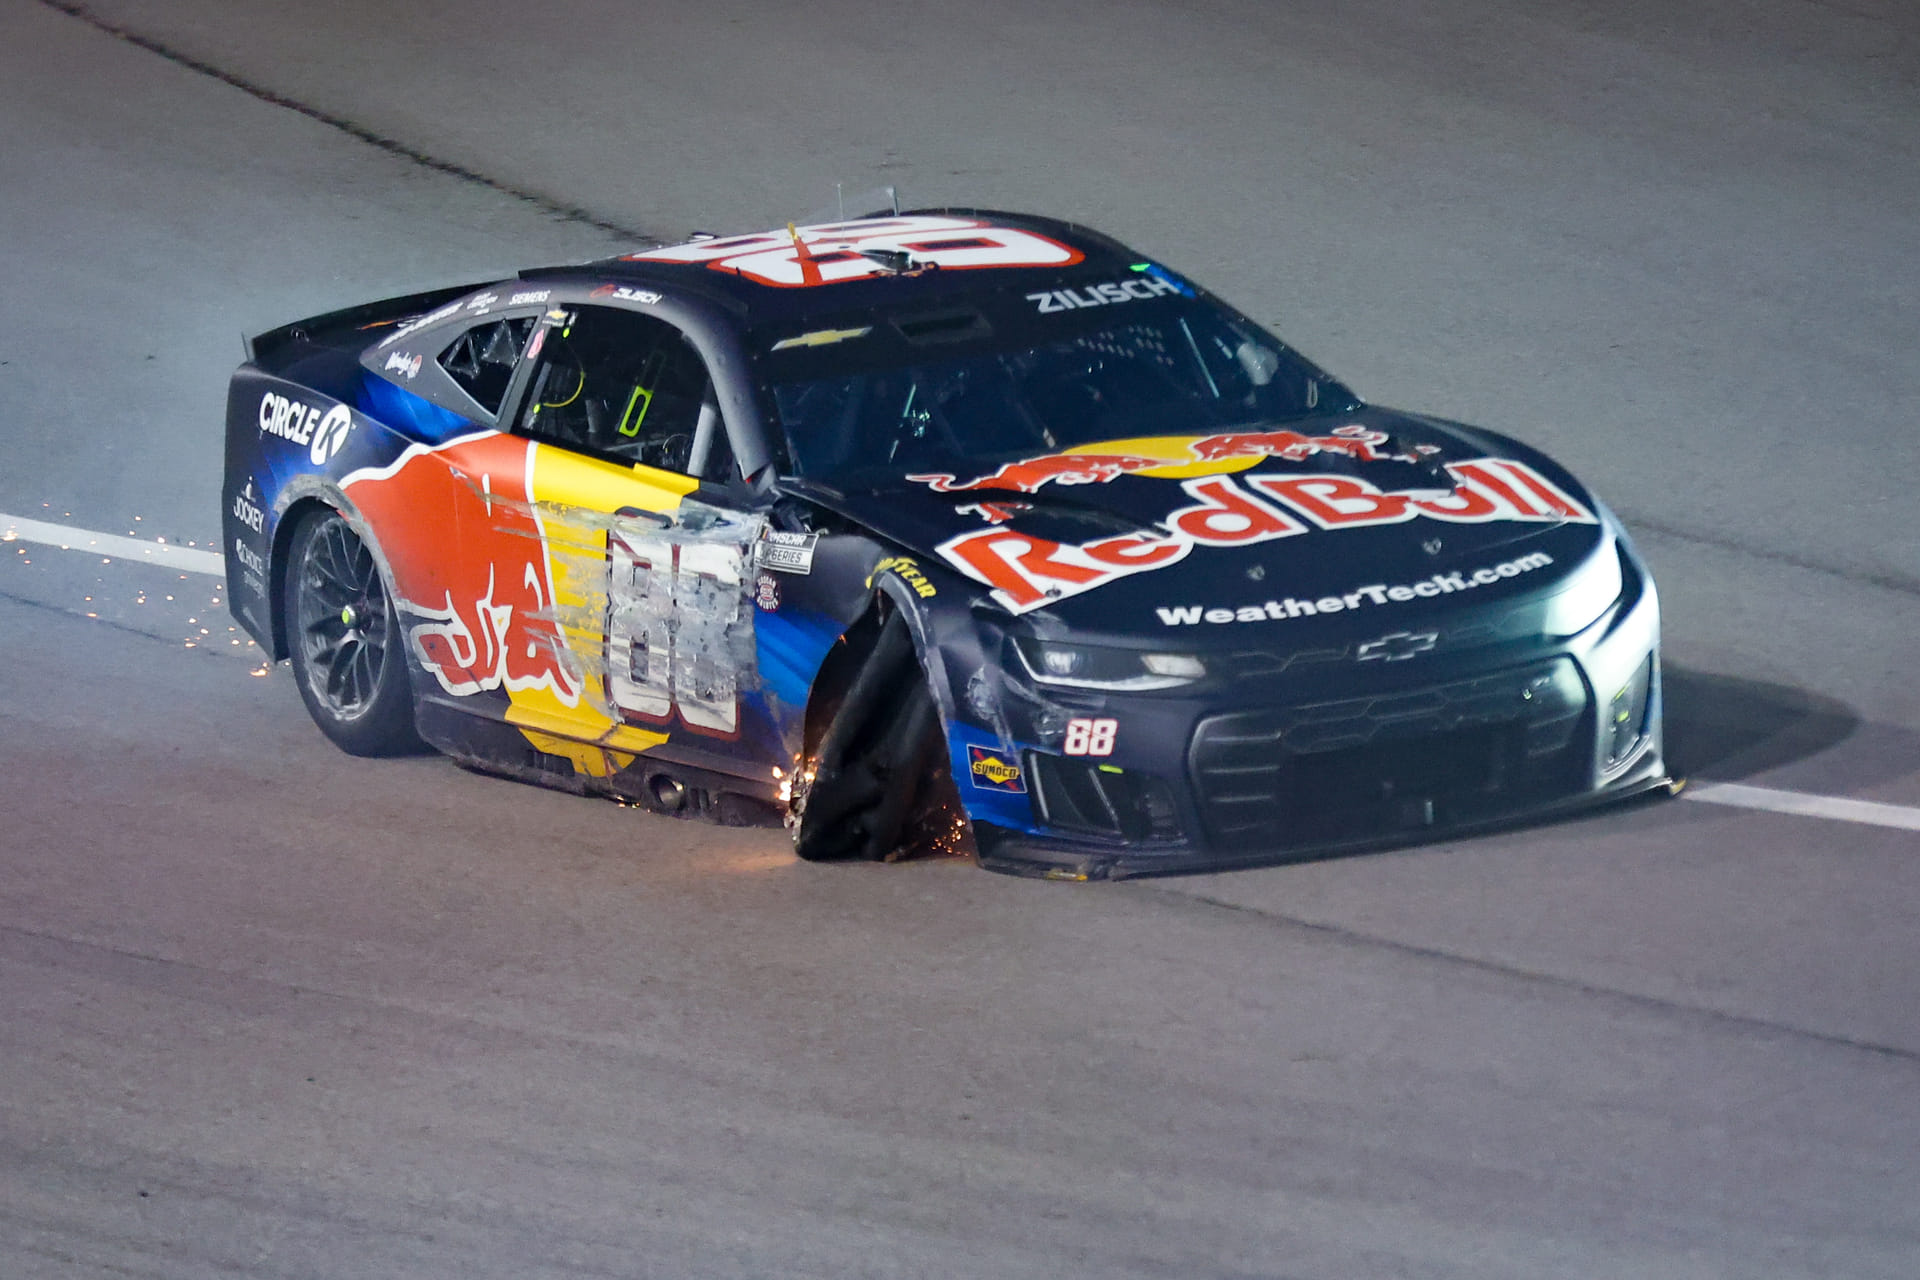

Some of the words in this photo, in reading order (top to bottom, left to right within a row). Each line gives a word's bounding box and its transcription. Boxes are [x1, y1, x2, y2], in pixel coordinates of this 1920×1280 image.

[509, 290, 551, 306] SIEMENS
[1024, 275, 1181, 315] ZILISCH
[259, 392, 321, 447] CIRCLE
[313, 406, 350, 465] K
[233, 496, 264, 535] JOCKEY
[1156, 551, 1554, 627] WeatherTech.com
[1064, 718, 1119, 757] 88
[973, 762, 1019, 778] SUNOCO
